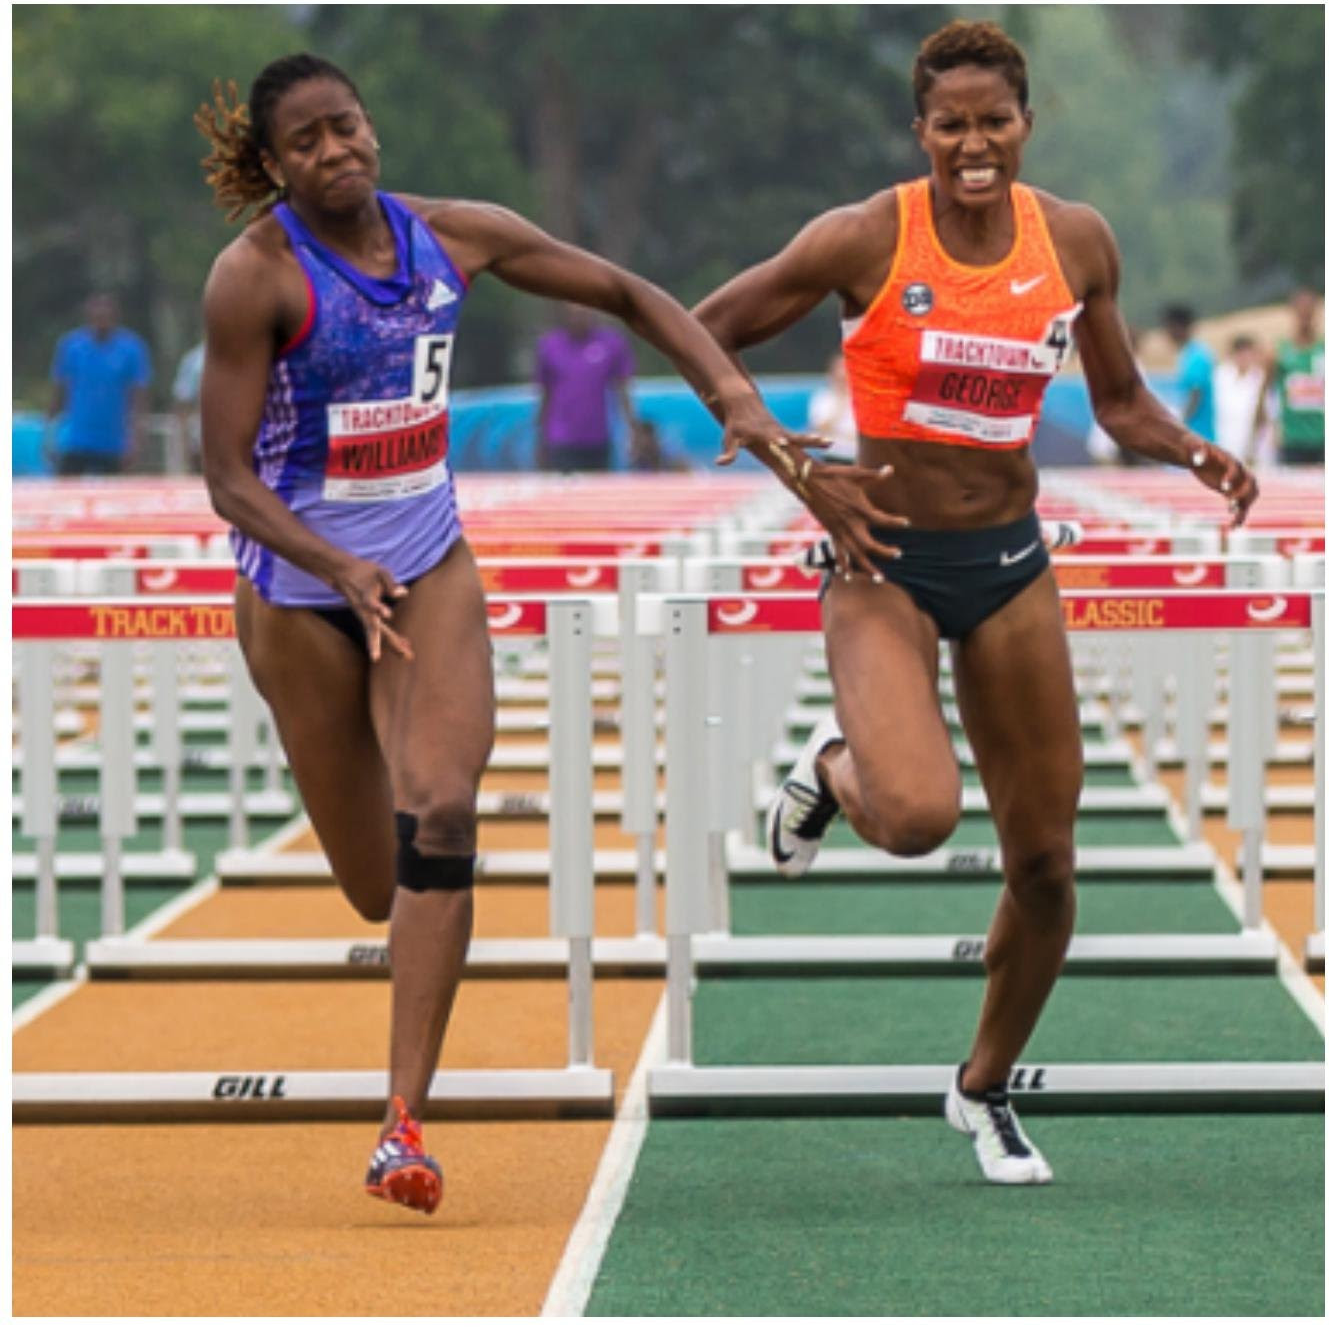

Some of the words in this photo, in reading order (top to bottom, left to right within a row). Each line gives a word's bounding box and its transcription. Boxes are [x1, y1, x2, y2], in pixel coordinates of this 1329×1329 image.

[421, 341, 446, 401] 5
[89, 607, 187, 636] TRACK
[212, 1076, 285, 1097] GILL
